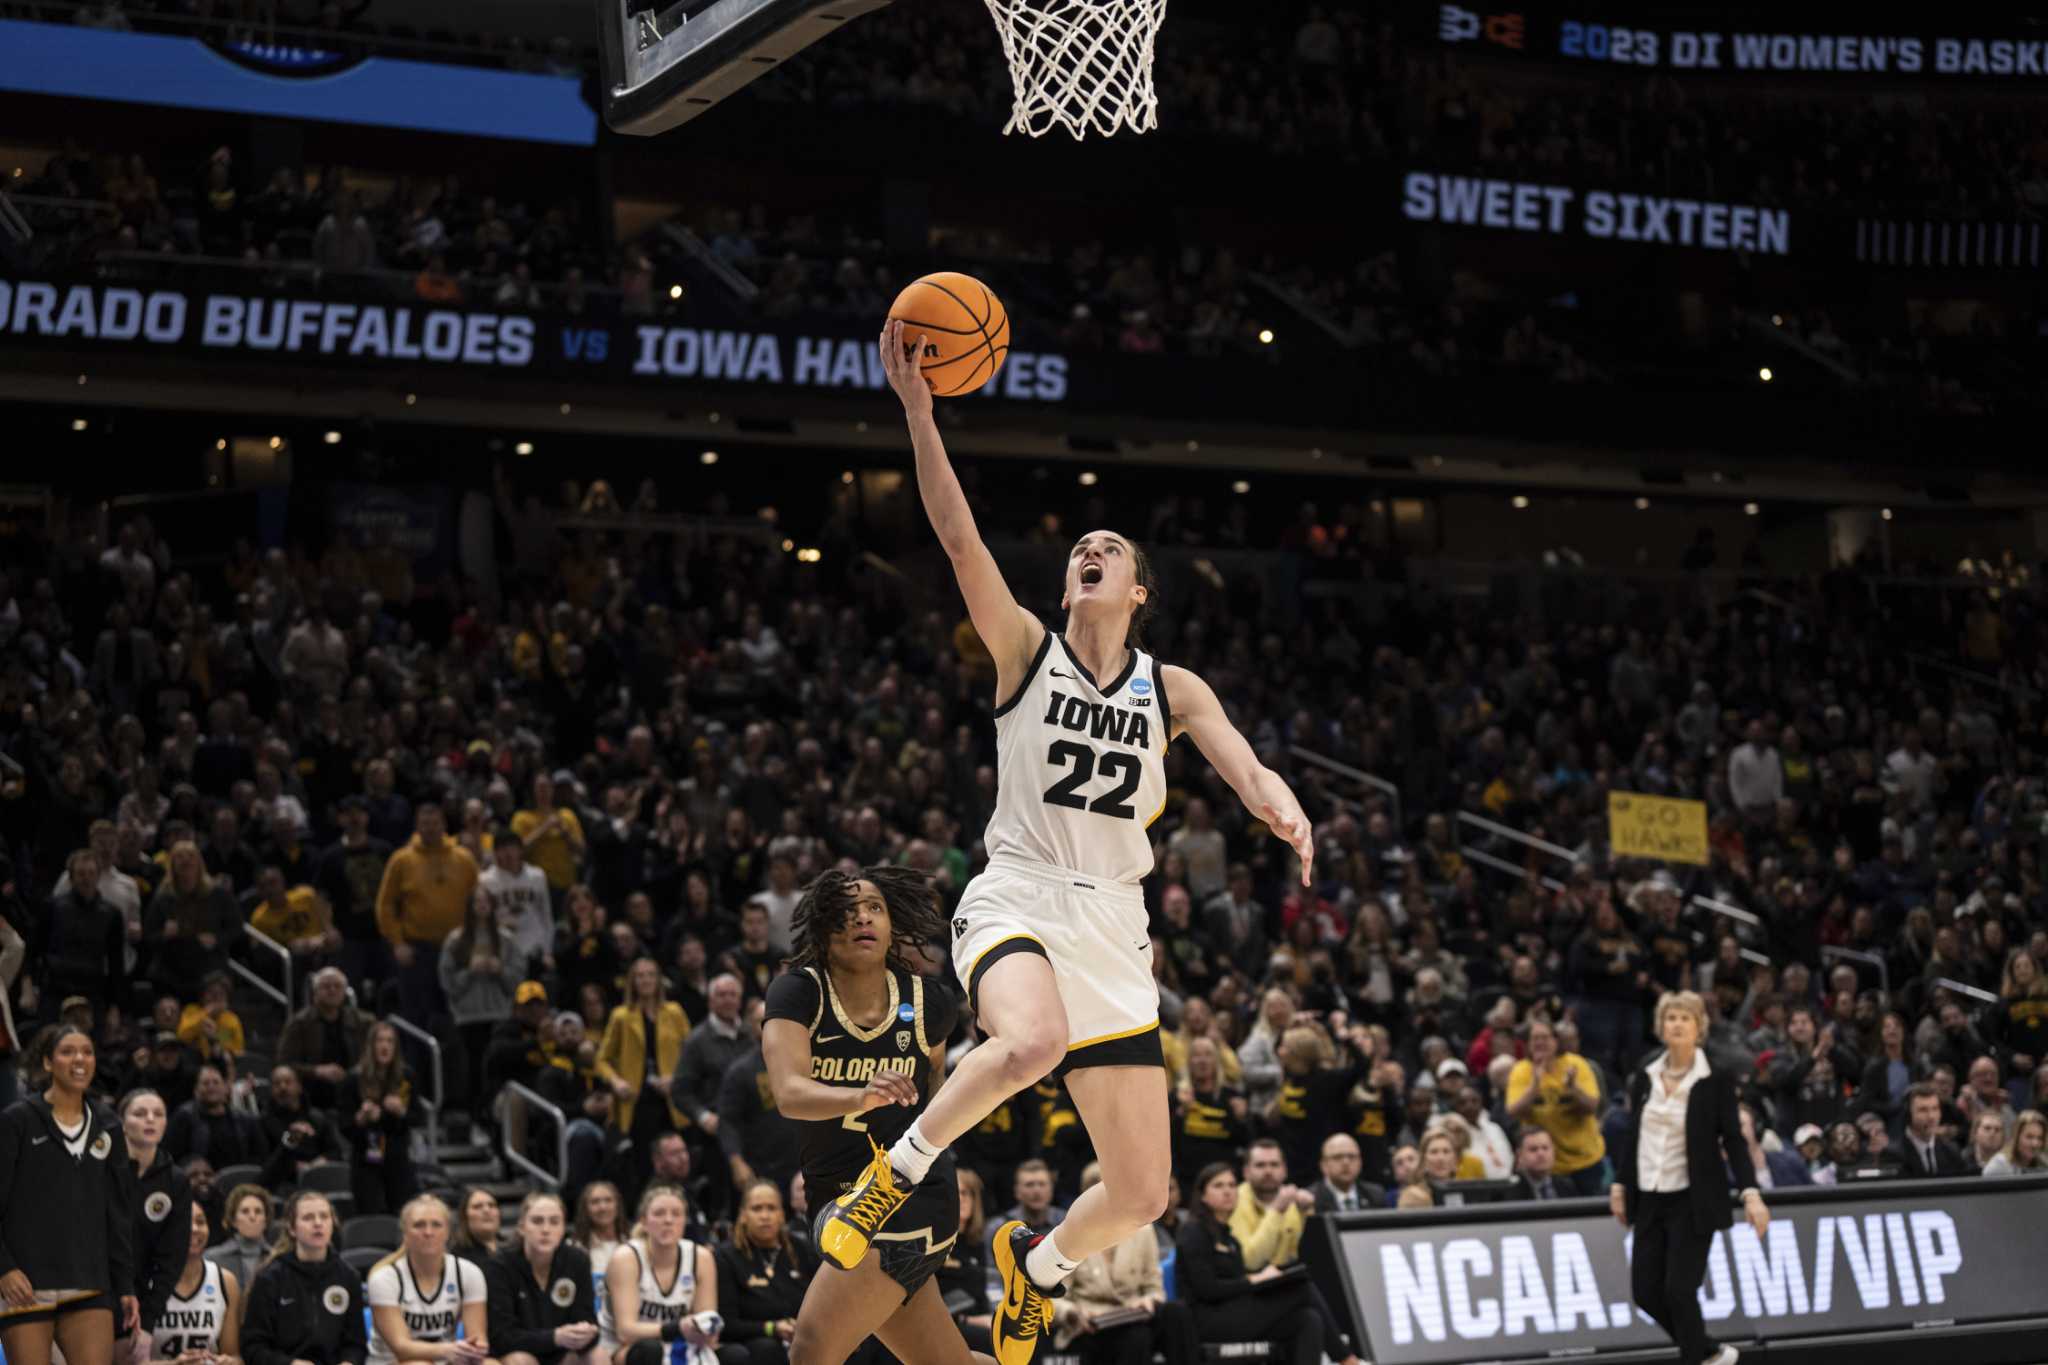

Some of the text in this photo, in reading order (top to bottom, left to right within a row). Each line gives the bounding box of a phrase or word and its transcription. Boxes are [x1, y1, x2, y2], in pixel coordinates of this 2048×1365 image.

[1560, 20, 2048, 75] 2023 DI WOMEN'S BASK
[1404, 171, 1790, 255] SWEET SIXTEEN
[202, 295, 535, 366] BUFFALOES
[562, 328, 609, 362] VS
[633, 325, 783, 384] IOWA
[1044, 690, 1149, 749] IOWA
[1042, 739, 1142, 819] 22
[810, 1055, 917, 1082] COLORADO
[1380, 1210, 1962, 1345] NCAA.OM/VIP
